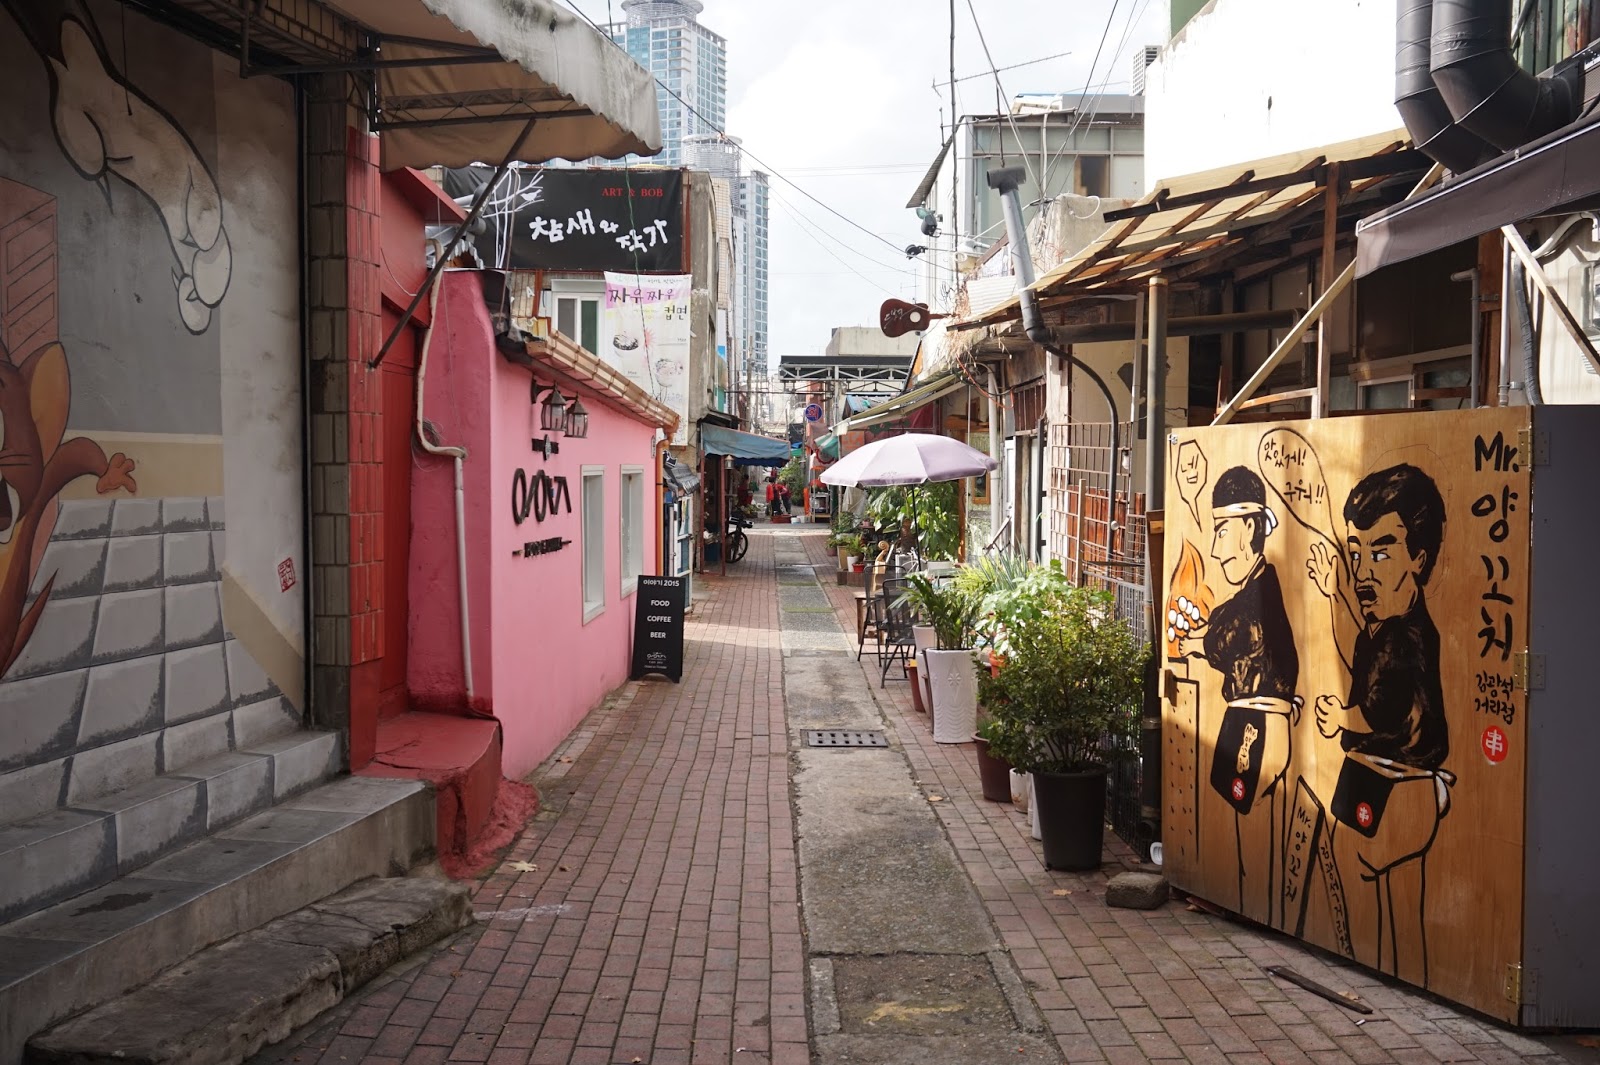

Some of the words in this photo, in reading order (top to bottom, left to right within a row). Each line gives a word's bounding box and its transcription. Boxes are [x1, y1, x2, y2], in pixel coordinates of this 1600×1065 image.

[602, 188, 623, 197] ART
[640, 188, 664, 197] BOB
[1474, 431, 1520, 473] Mr.
[1471, 484, 1519, 662] 양꼬치
[647, 615, 672, 623] COFFEE
[1476, 670, 1514, 701] 김광석
[1475, 696, 1516, 726] 거리점
[1297, 806, 1312, 829] Mr.
